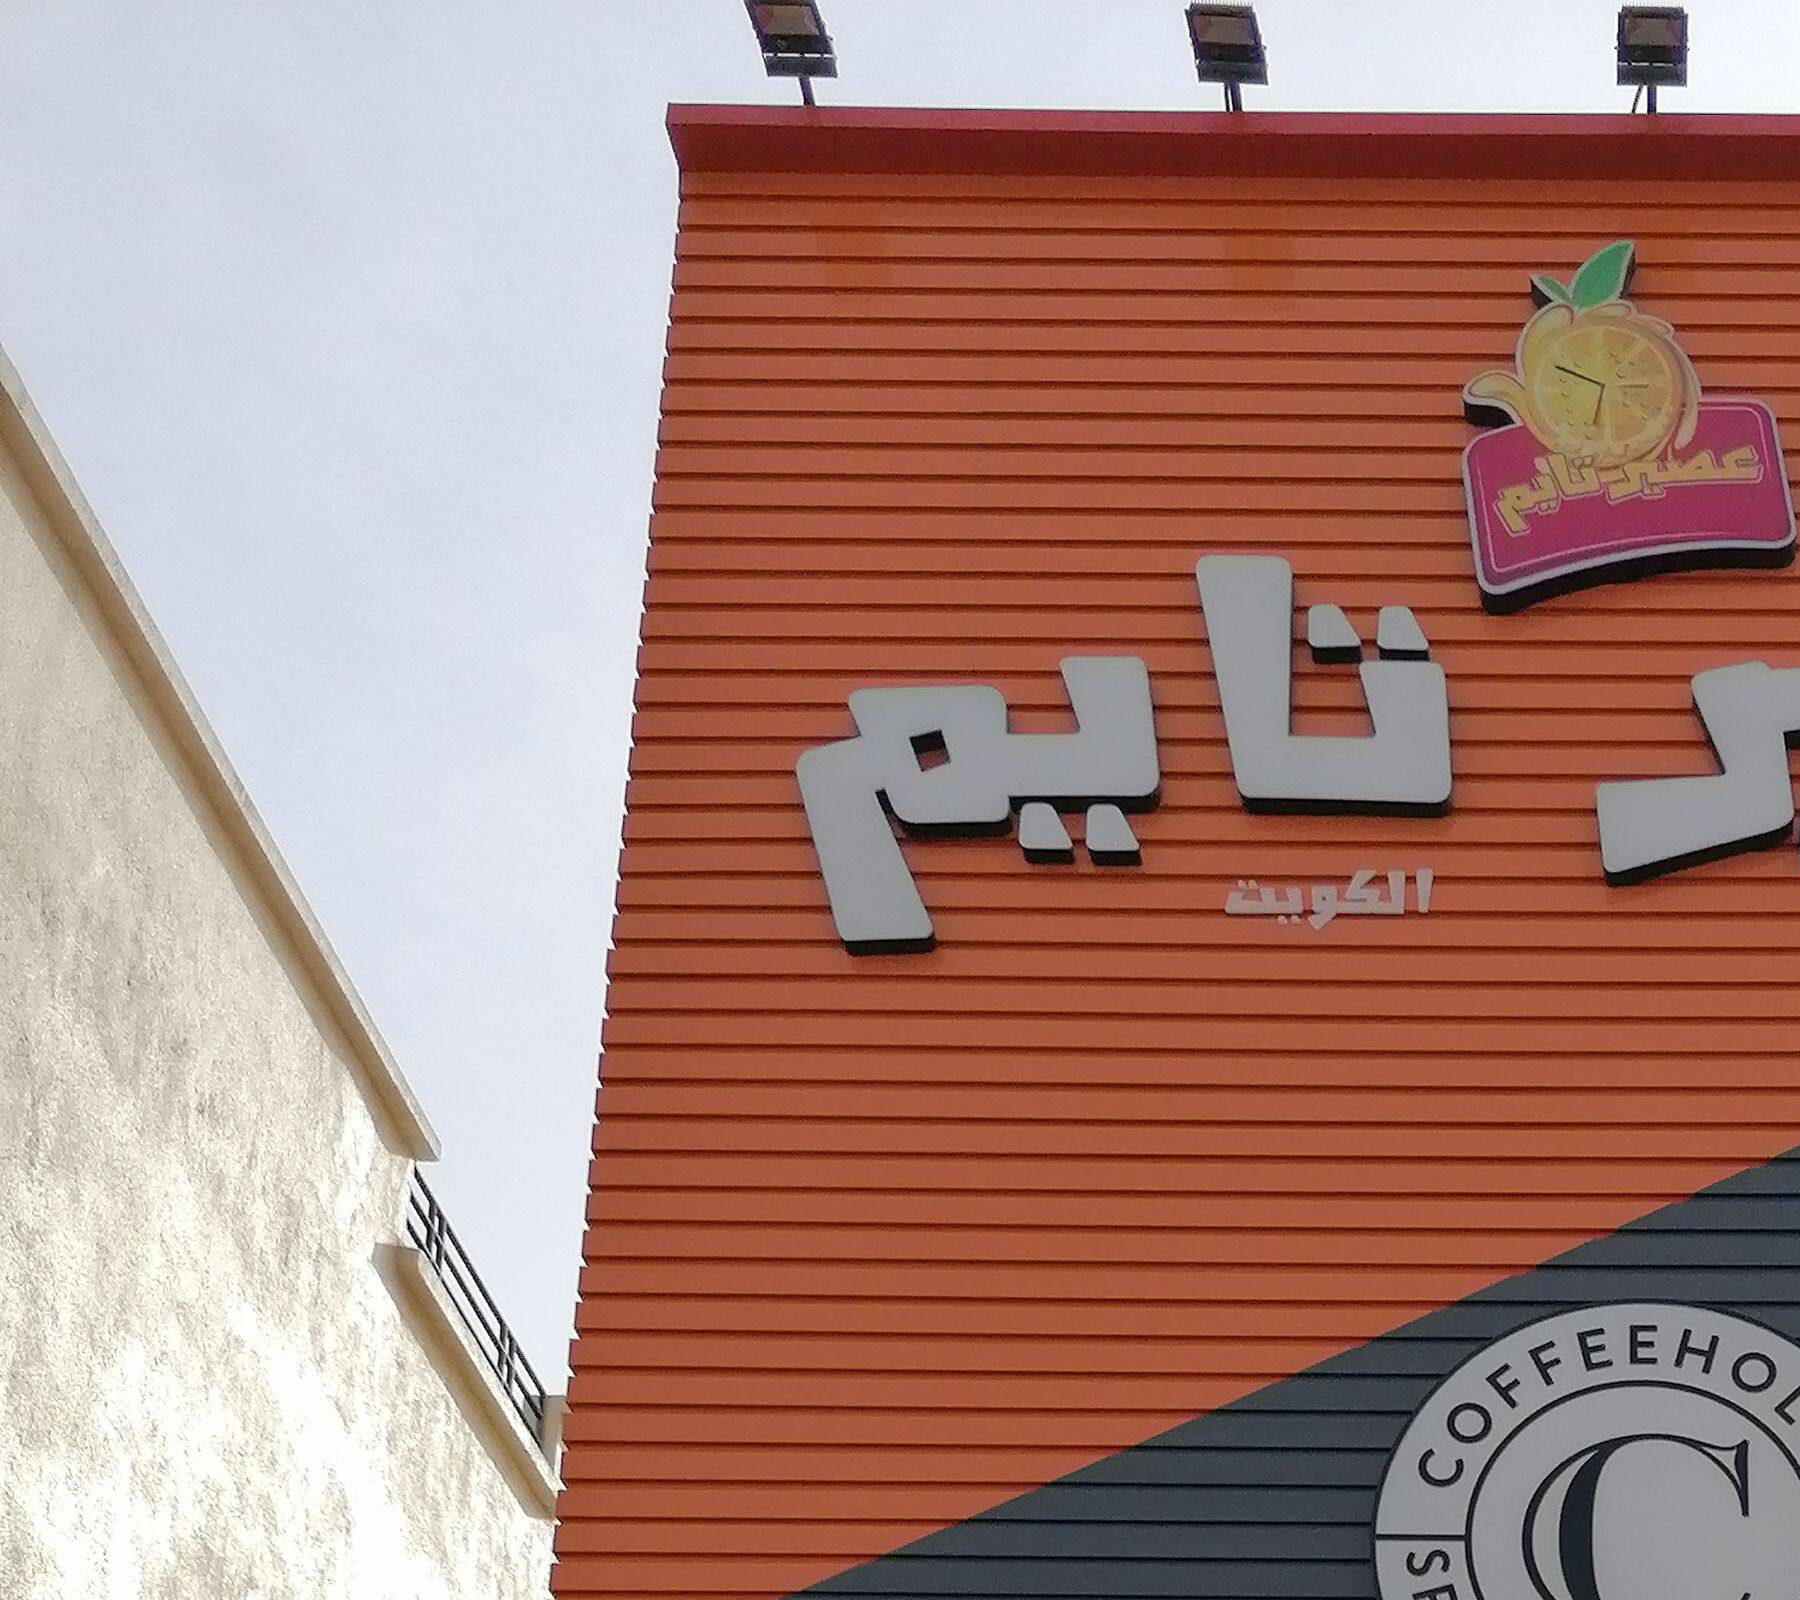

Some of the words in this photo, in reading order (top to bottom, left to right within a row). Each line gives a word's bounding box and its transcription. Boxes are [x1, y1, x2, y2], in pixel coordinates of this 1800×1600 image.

[1494, 453, 1603, 537] تايم
[1605, 445, 1764, 505] عصير
[796, 556, 1452, 952] تايم
[1225, 868, 1433, 931] الكويت
